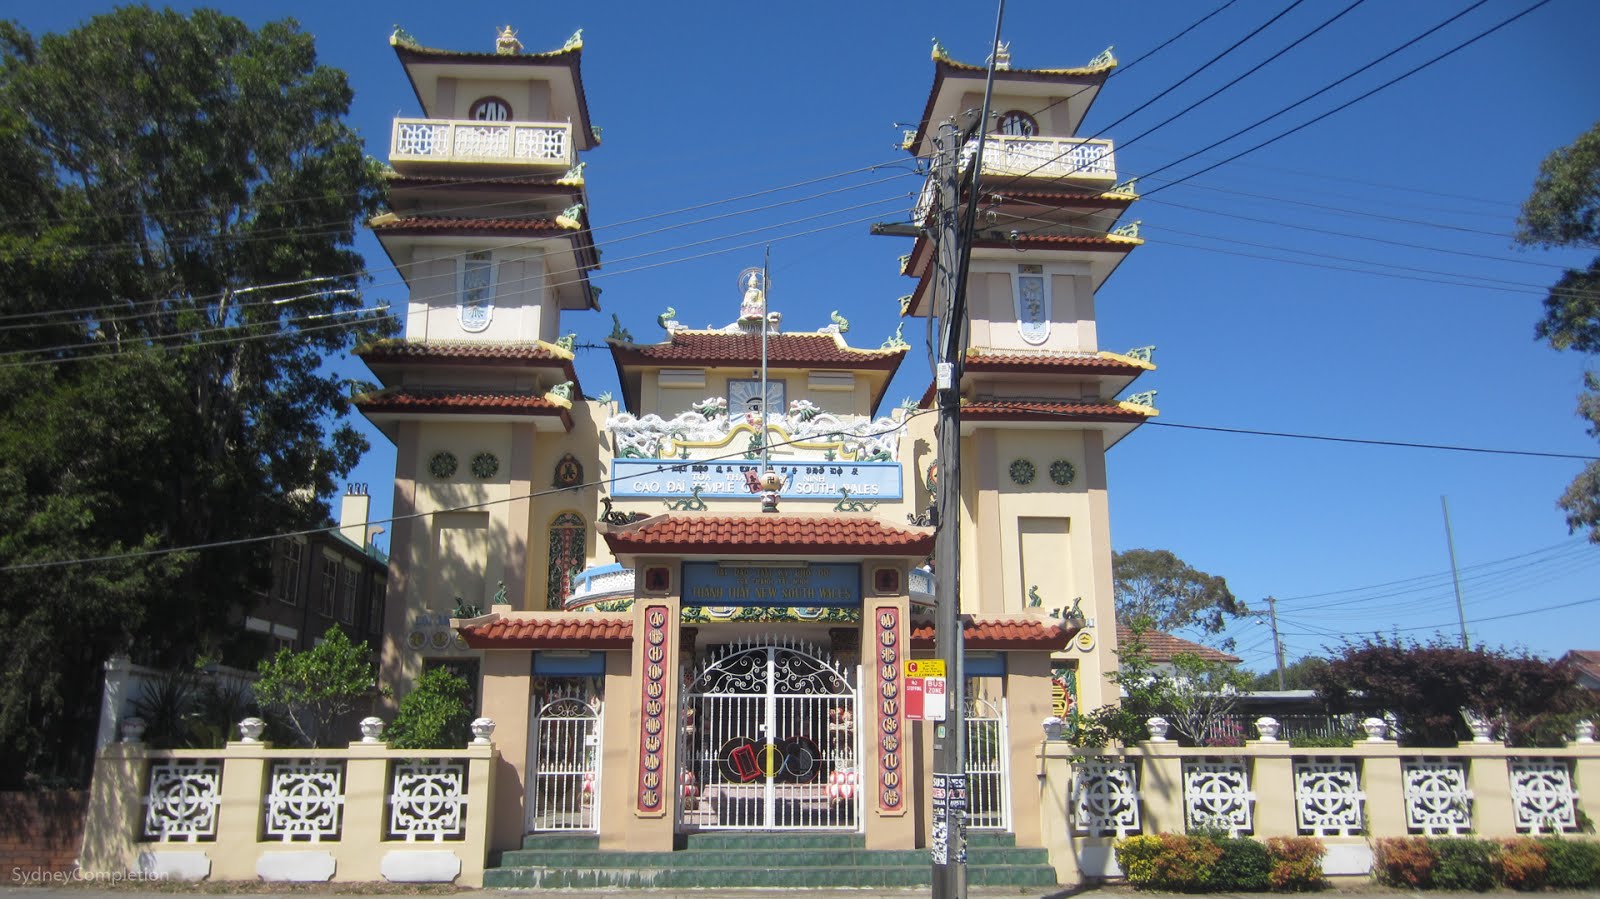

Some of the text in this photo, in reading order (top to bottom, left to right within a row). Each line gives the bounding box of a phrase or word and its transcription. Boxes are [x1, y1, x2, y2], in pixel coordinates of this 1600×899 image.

[633, 482, 660, 493] CAO
[692, 482, 734, 493] TEMPLE
[796, 483, 836, 494] SOUTH
[755, 587, 777, 598] NEW
[782, 587, 814, 598] SOUTH
[819, 588, 851, 599] WALES
[909, 662, 916, 672] C
